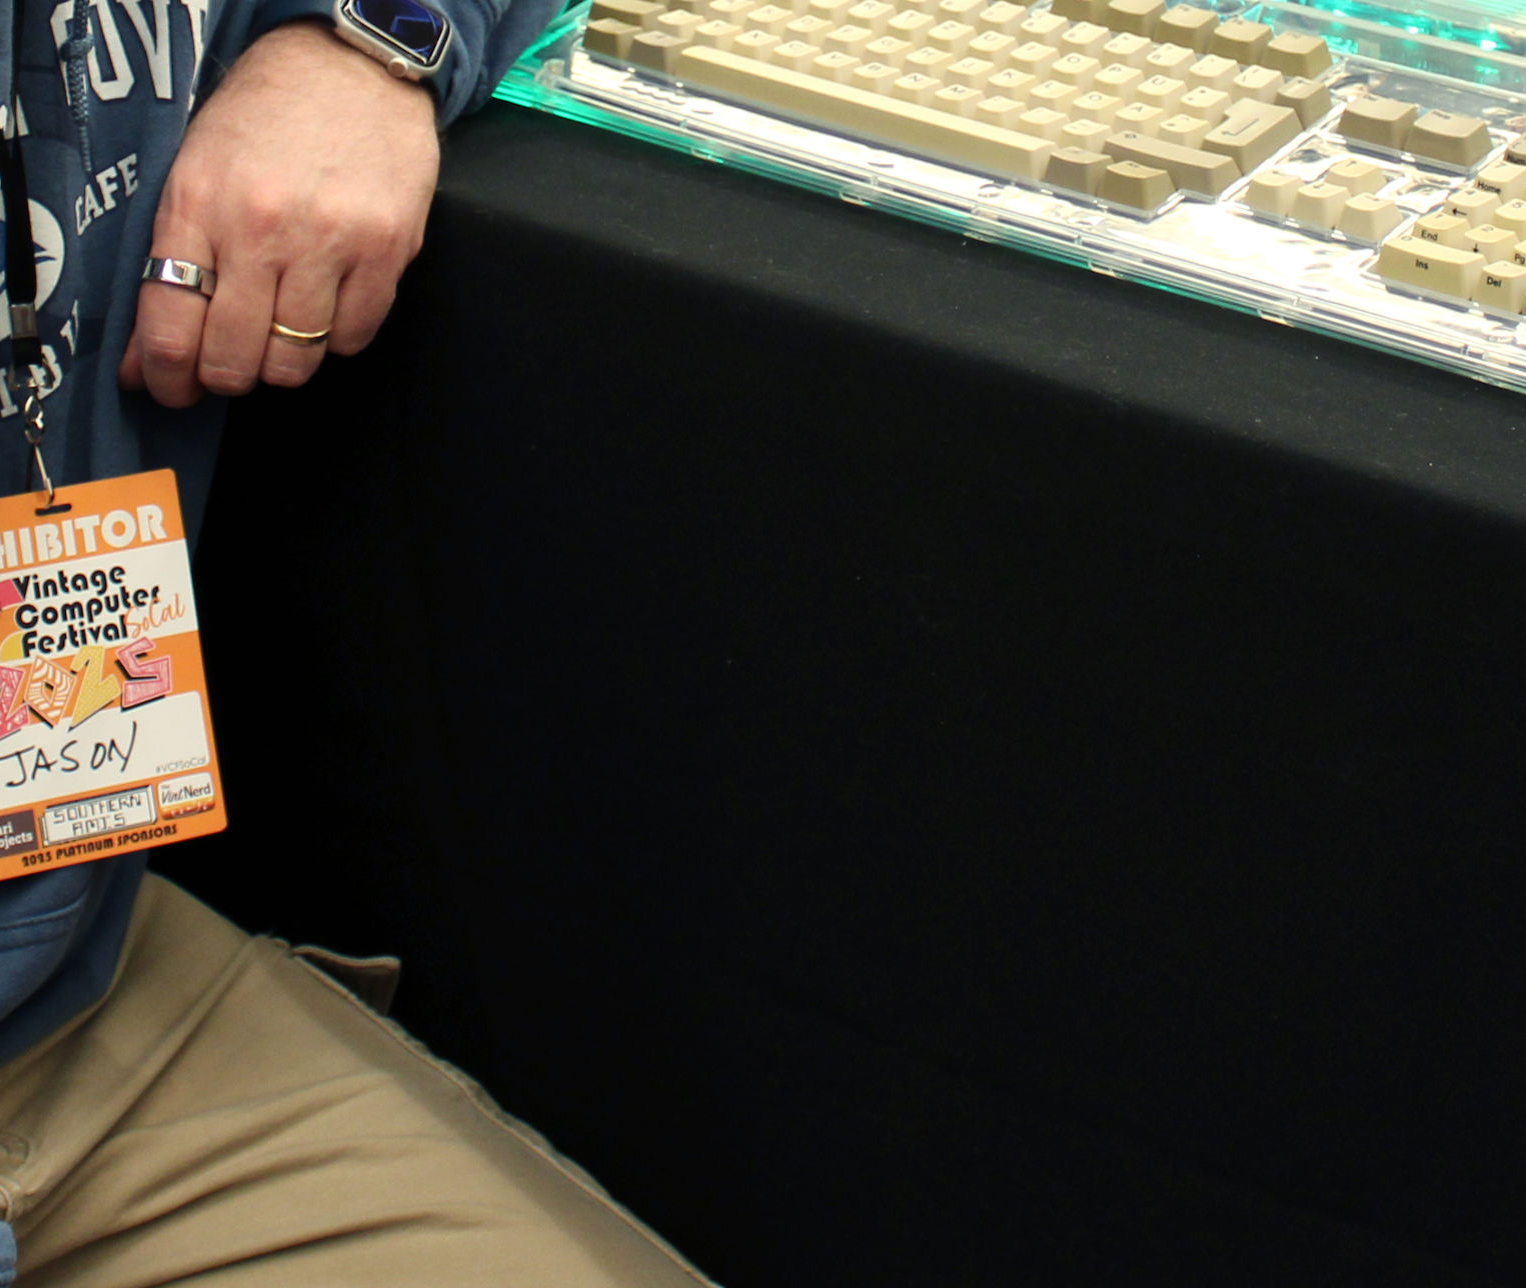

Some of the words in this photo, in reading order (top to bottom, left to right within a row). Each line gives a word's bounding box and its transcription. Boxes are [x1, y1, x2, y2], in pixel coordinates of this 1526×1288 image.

[75, 153, 139, 235] CAFE
[1477, 181, 1501, 194] Home
[1421, 230, 1439, 241] End
[1415, 258, 1429, 270] Ins
[1486, 275, 1502, 288] Del
[12, 566, 126, 601] Vintage
[14, 585, 160, 629] Computer
[22, 614, 128, 658] Festival
[55, 837, 114, 861] PLATINUM
[117, 823, 179, 847] SPONSORS
